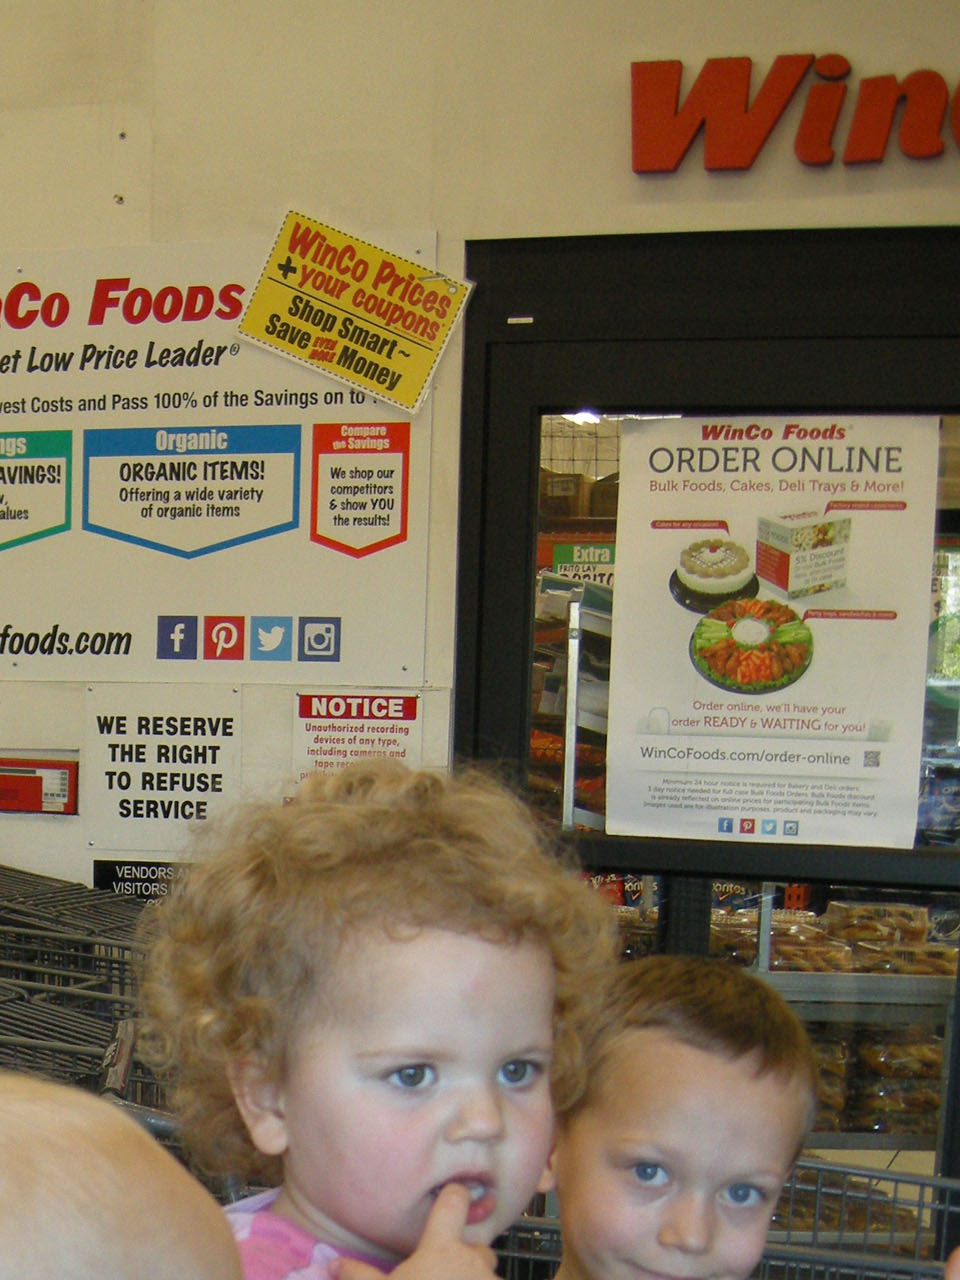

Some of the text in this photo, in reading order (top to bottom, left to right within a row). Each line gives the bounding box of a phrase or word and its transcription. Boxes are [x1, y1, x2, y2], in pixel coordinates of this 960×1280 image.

[631, 54, 960, 174] Win
[288, 221, 452, 320] WinCo Prices
[297, 264, 350, 300] your
[352, 288, 441, 342] coupons
[288, 294, 337, 333] Shop
[337, 317, 398, 360] Smart
[26, 346, 74, 374] Low
[78, 343, 137, 372] Price
[265, 313, 403, 392] Save Money
[30, 396, 73, 413] Costs
[78, 395, 106, 411] and
[112, 394, 148, 410] Pass
[154, 392, 197, 409] 100%
[203, 391, 219, 408] of
[223, 390, 249, 407] the
[254, 389, 318, 409] Savings
[324, 391, 343, 405] on
[349, 389, 365, 404] to
[341, 425, 387, 438] Compare
[701, 424, 846, 440] WinCo Foods
[155, 429, 228, 453] Organic
[348, 437, 390, 451] Savings
[649, 446, 903, 473] ORDER ONLINE
[119, 460, 265, 482] ORGANIC ITEMS!
[330, 467, 395, 481] We shop our
[330, 483, 394, 497] competitors
[649, 479, 904, 493] Bulk Foods, Cakes, Deli Trays More!
[119, 487, 264, 503] Offering wide variety
[141, 504, 240, 520] of organic items
[340, 498, 394, 511] show YOU
[333, 514, 390, 527] the results!
[573, 546, 610, 562] Extra
[311, 697, 404, 718] NOTICE
[692, 700, 723, 711] Order
[793, 703, 819, 714] have
[821, 706, 846, 716] your
[96, 715, 234, 736] WE RESERVE
[305, 722, 410, 736] Unauthorized recording
[671, 717, 700, 727] order
[704, 716, 747, 729] READY
[761, 718, 822, 731] WAITING
[823, 721, 839, 731] for
[313, 735, 345, 745] devices
[108, 743, 221, 764] THE RIGHT
[307, 746, 347, 758] including
[389, 748, 406, 758] and
[640, 746, 851, 765] WinCoFoods.com/order-online
[105, 771, 223, 792] TO REFUSE
[118, 798, 208, 820] SERVICE
[116, 865, 174, 879] VENDORS
[113, 881, 168, 895] VISITORS
